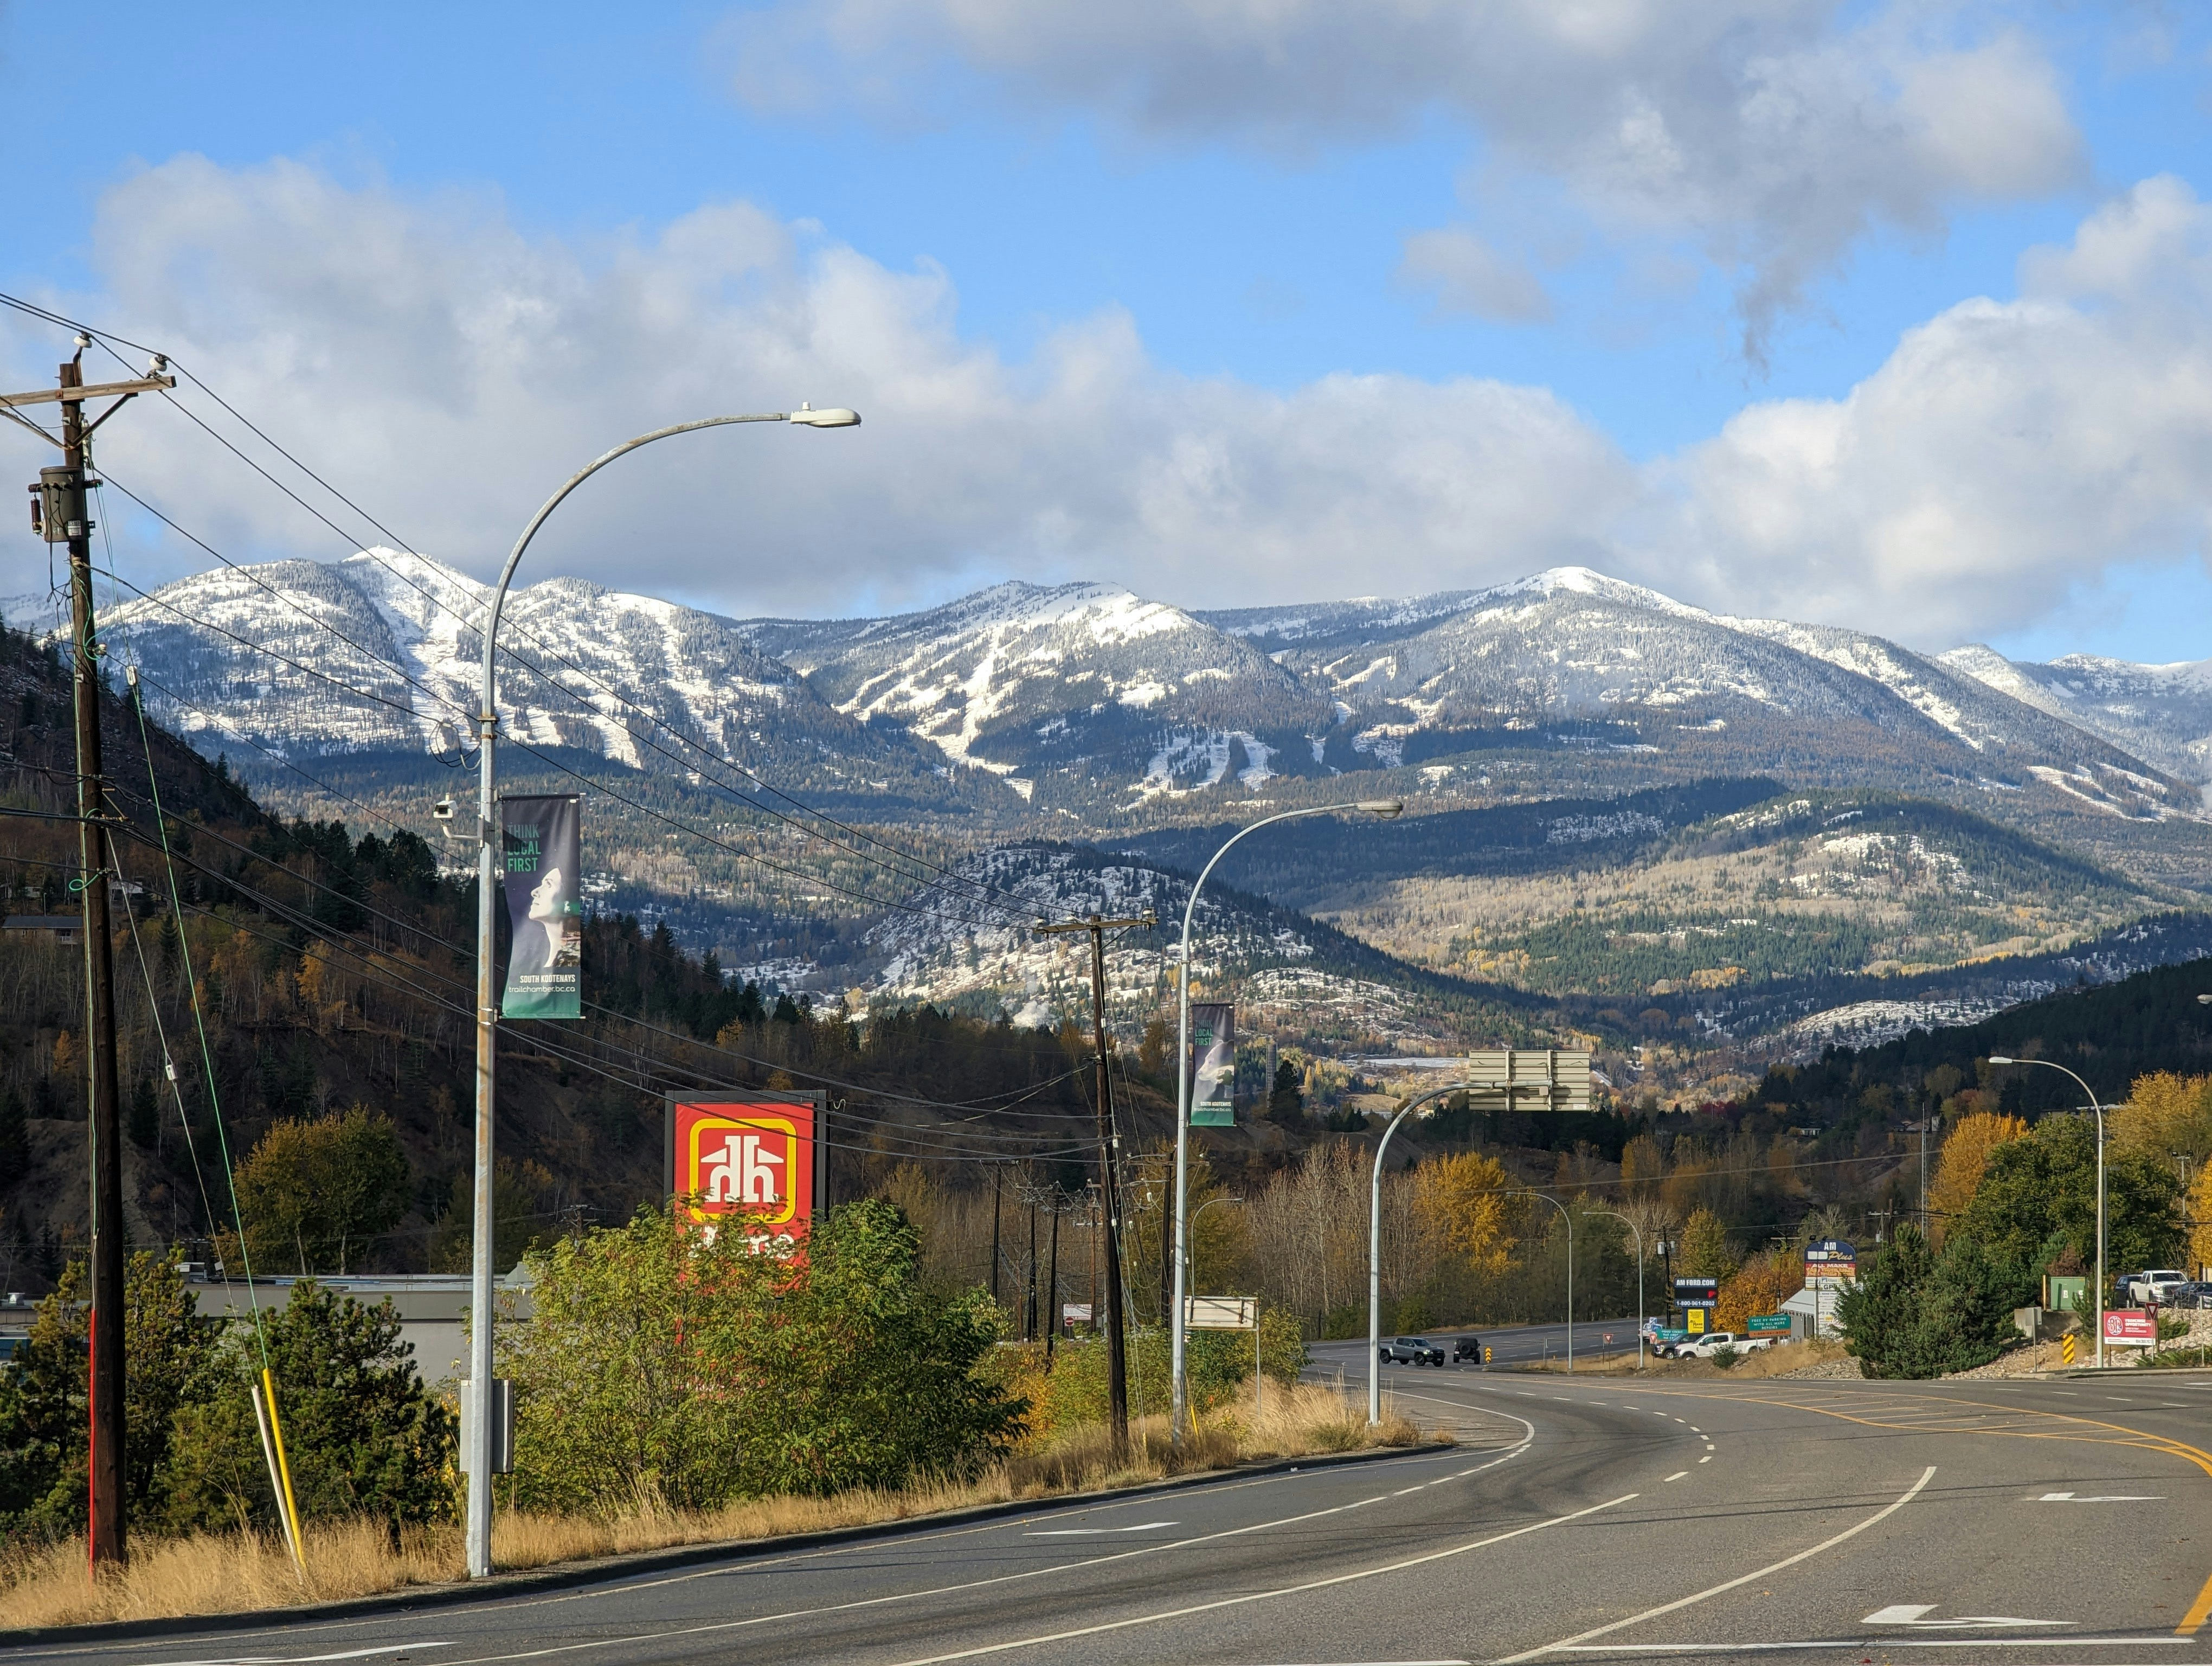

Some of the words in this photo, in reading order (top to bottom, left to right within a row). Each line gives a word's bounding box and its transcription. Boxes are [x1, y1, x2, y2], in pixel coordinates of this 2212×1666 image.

[507, 824, 539, 838] THINK
[507, 841, 541, 855] LOCAL
[508, 857, 538, 872] FIRST
[520, 975, 539, 983] SOUTH
[541, 975, 575, 983] KOOTENAYS
[1195, 1029, 1213, 1037] LOCAL
[1195, 1037, 1211, 1046] FIRST
[1824, 1242, 1836, 1251] AM
[1828, 1251, 1854, 1260] Plus
